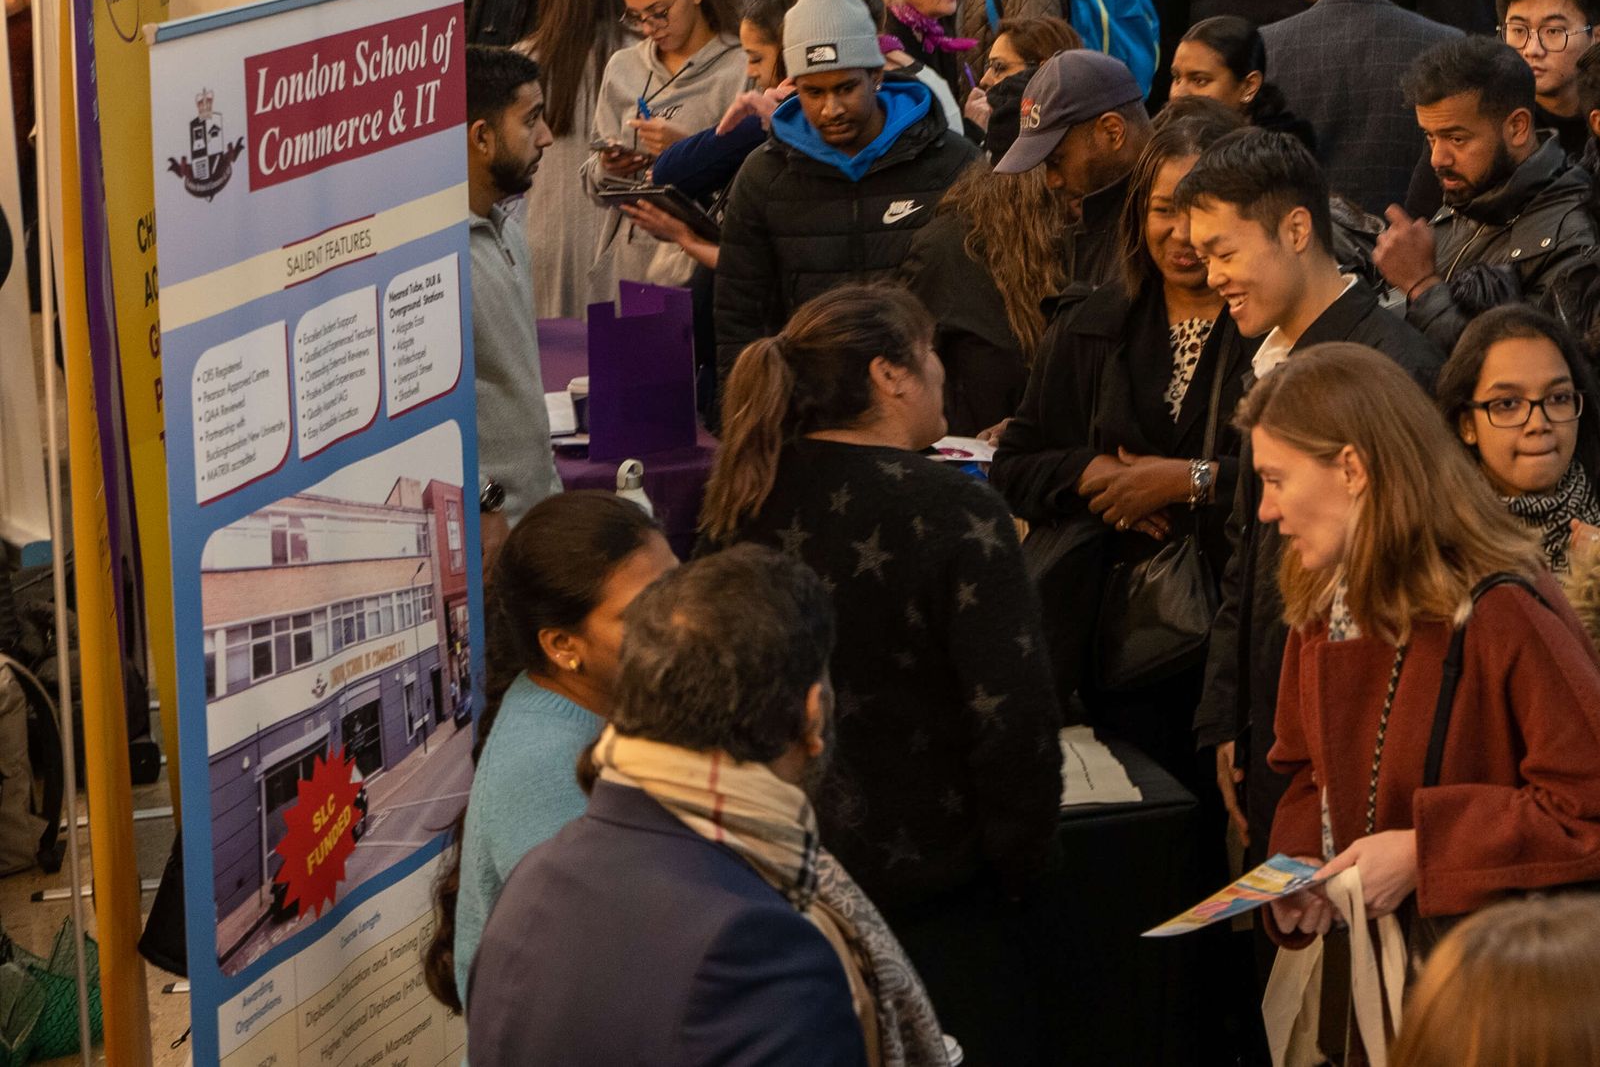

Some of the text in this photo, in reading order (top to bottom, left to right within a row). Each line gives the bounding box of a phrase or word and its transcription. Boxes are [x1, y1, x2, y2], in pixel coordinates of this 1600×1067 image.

[254, 16, 457, 116] London School of
[257, 79, 441, 176] Commerce & IT
[286, 229, 372, 278] SALIENT FEATURES
[306, 804, 353, 877] FUNDED
[312, 793, 337, 834] SLC
[384, 1015, 433, 1054] Management
